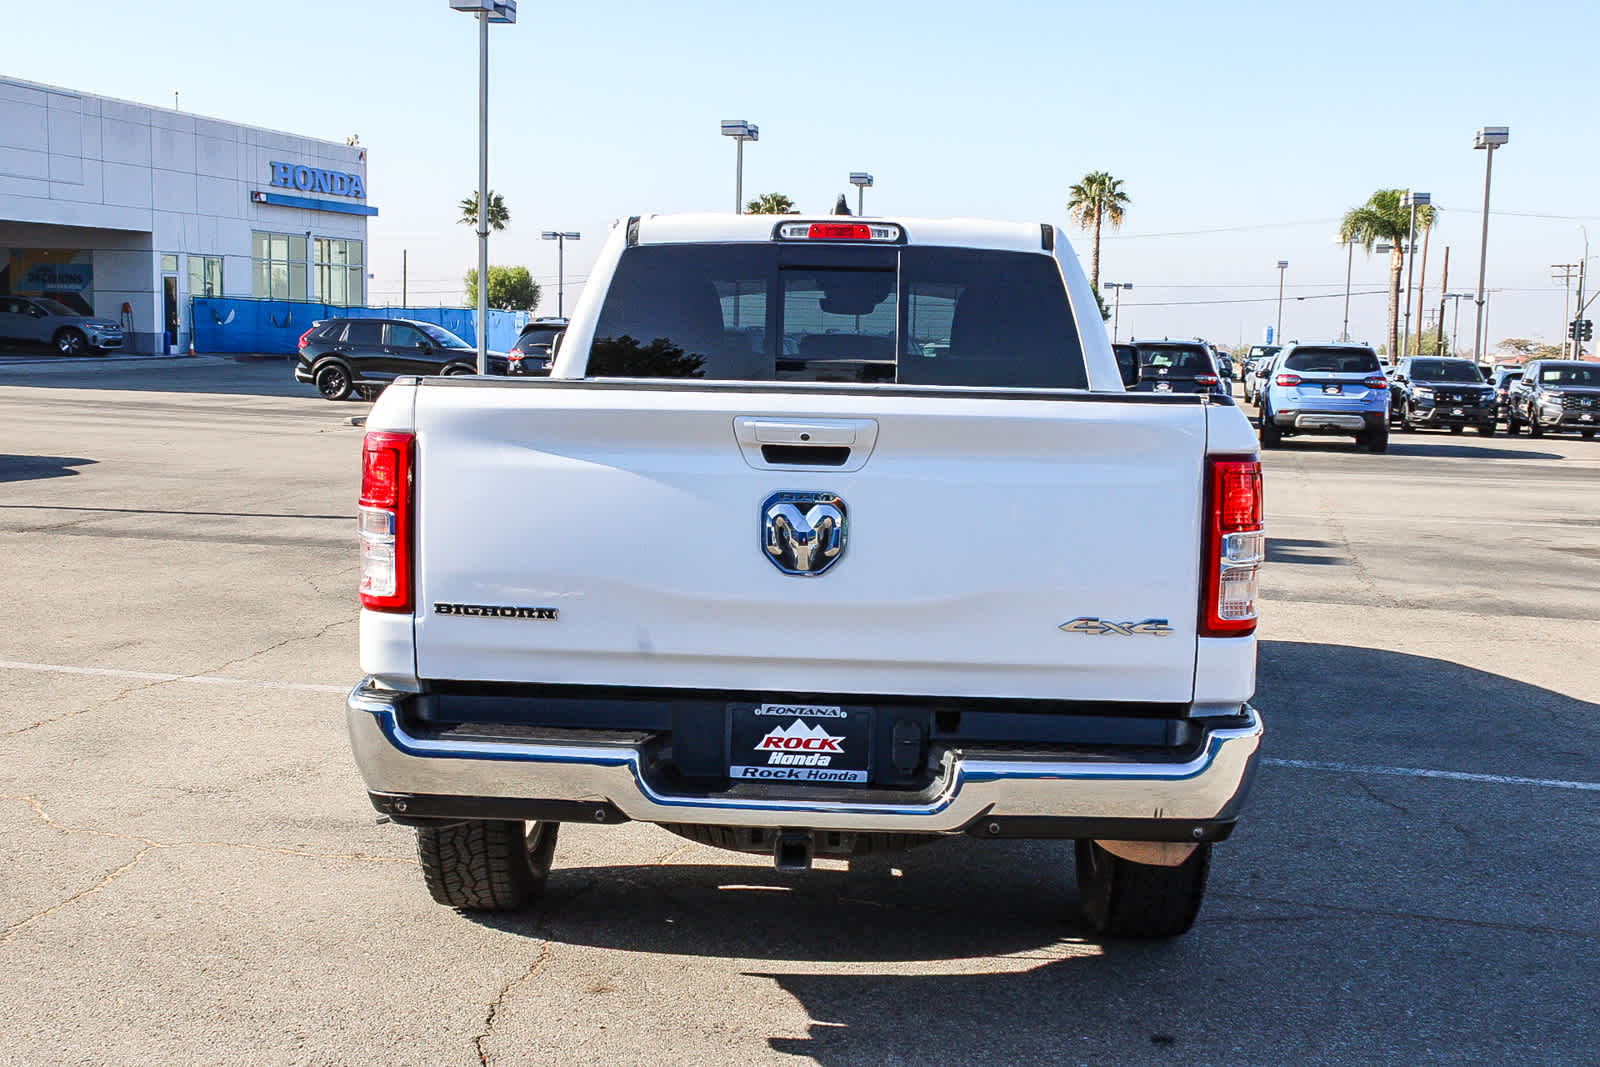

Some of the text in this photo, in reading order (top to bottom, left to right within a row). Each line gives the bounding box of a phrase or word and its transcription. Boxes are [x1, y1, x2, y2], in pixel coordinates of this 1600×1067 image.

[270, 161, 367, 199] HONDA
[766, 706, 838, 716] FONTANA
[763, 737, 839, 751] ROCK
[768, 751, 832, 767] Honda
[741, 767, 859, 781] Rock Honda
